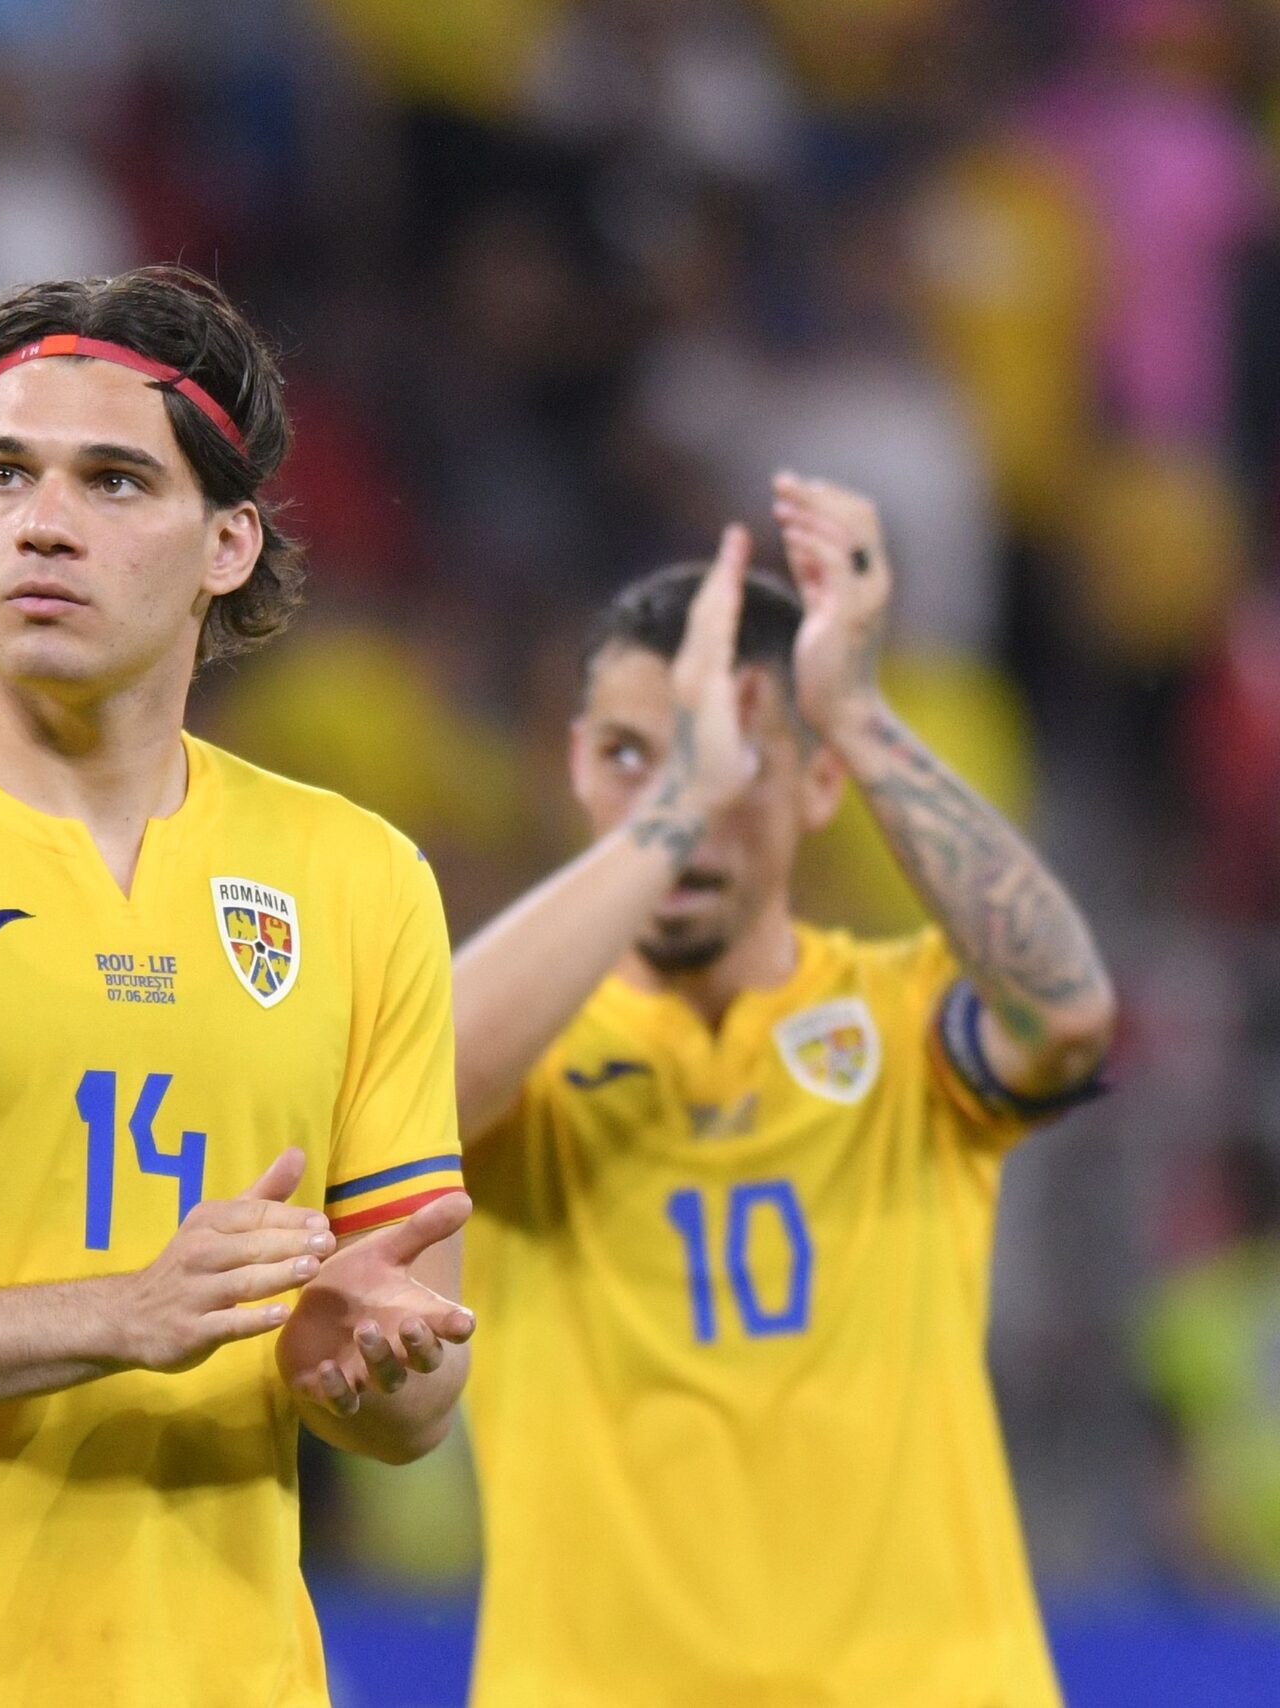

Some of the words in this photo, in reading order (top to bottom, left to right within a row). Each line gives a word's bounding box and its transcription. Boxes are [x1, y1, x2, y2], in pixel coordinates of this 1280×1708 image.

[219, 884, 289, 916] ROMÂNIA
[95, 953, 134, 971] ROU
[148, 955, 177, 974] LIE
[107, 988, 176, 1004] 07.06.2024
[75, 1070, 207, 1250] 14
[665, 1180, 813, 1343] 10
